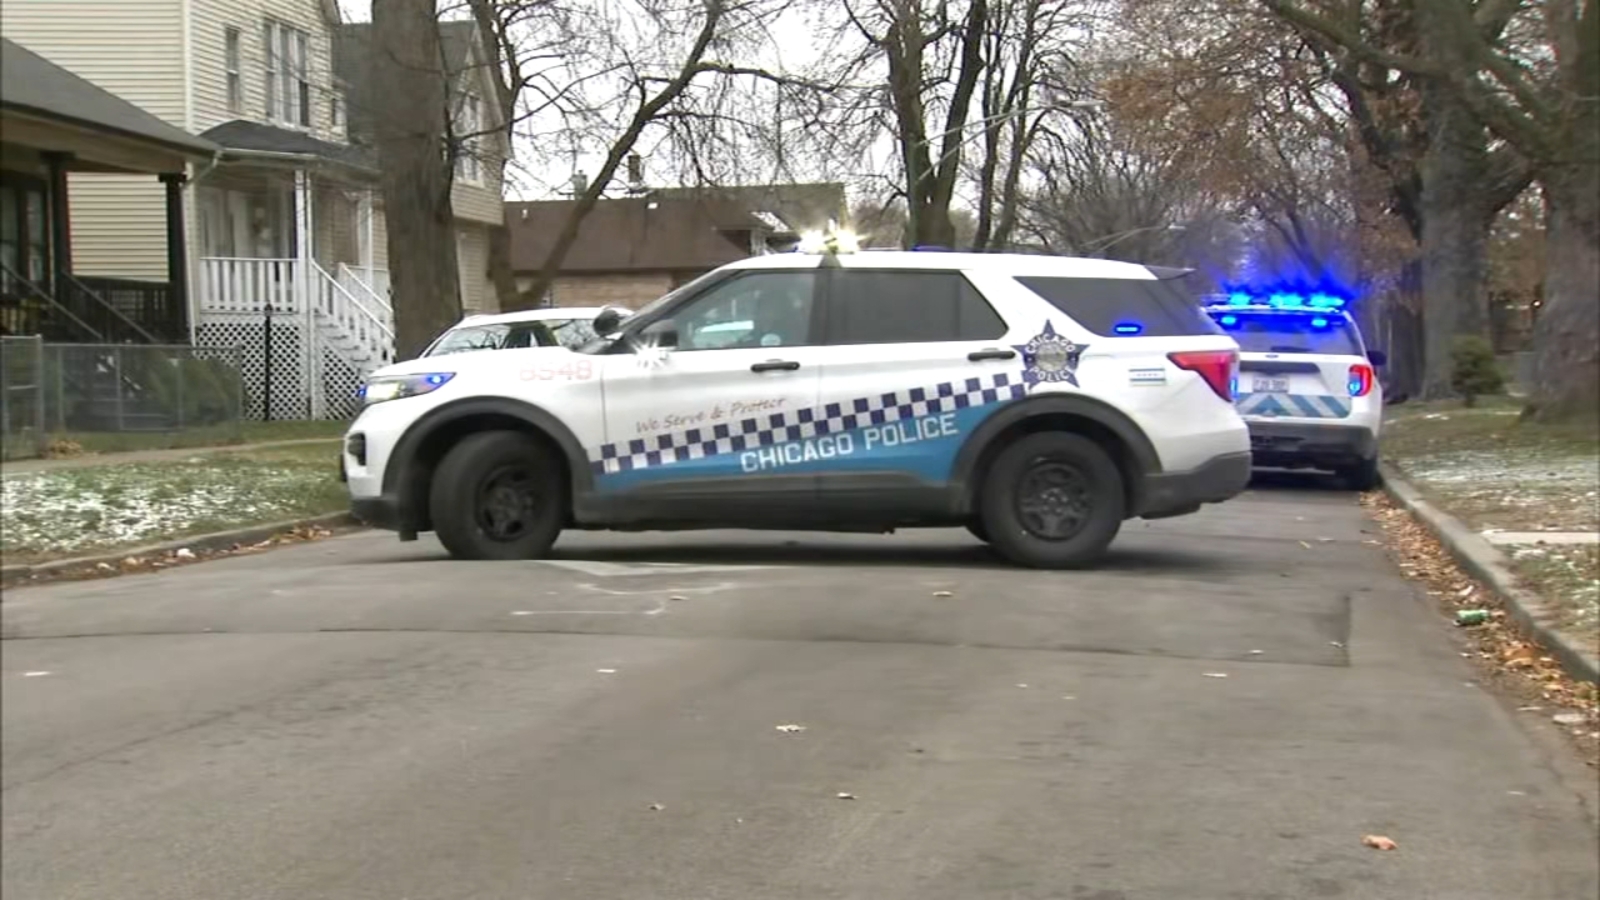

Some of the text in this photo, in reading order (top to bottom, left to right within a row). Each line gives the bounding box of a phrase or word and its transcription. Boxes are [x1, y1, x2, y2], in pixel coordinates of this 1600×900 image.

[636, 419, 660, 433] We
[664, 413, 704, 429] Serve
[731, 397, 786, 416] Protect
[740, 413, 959, 473] CHICAGO POLICE
